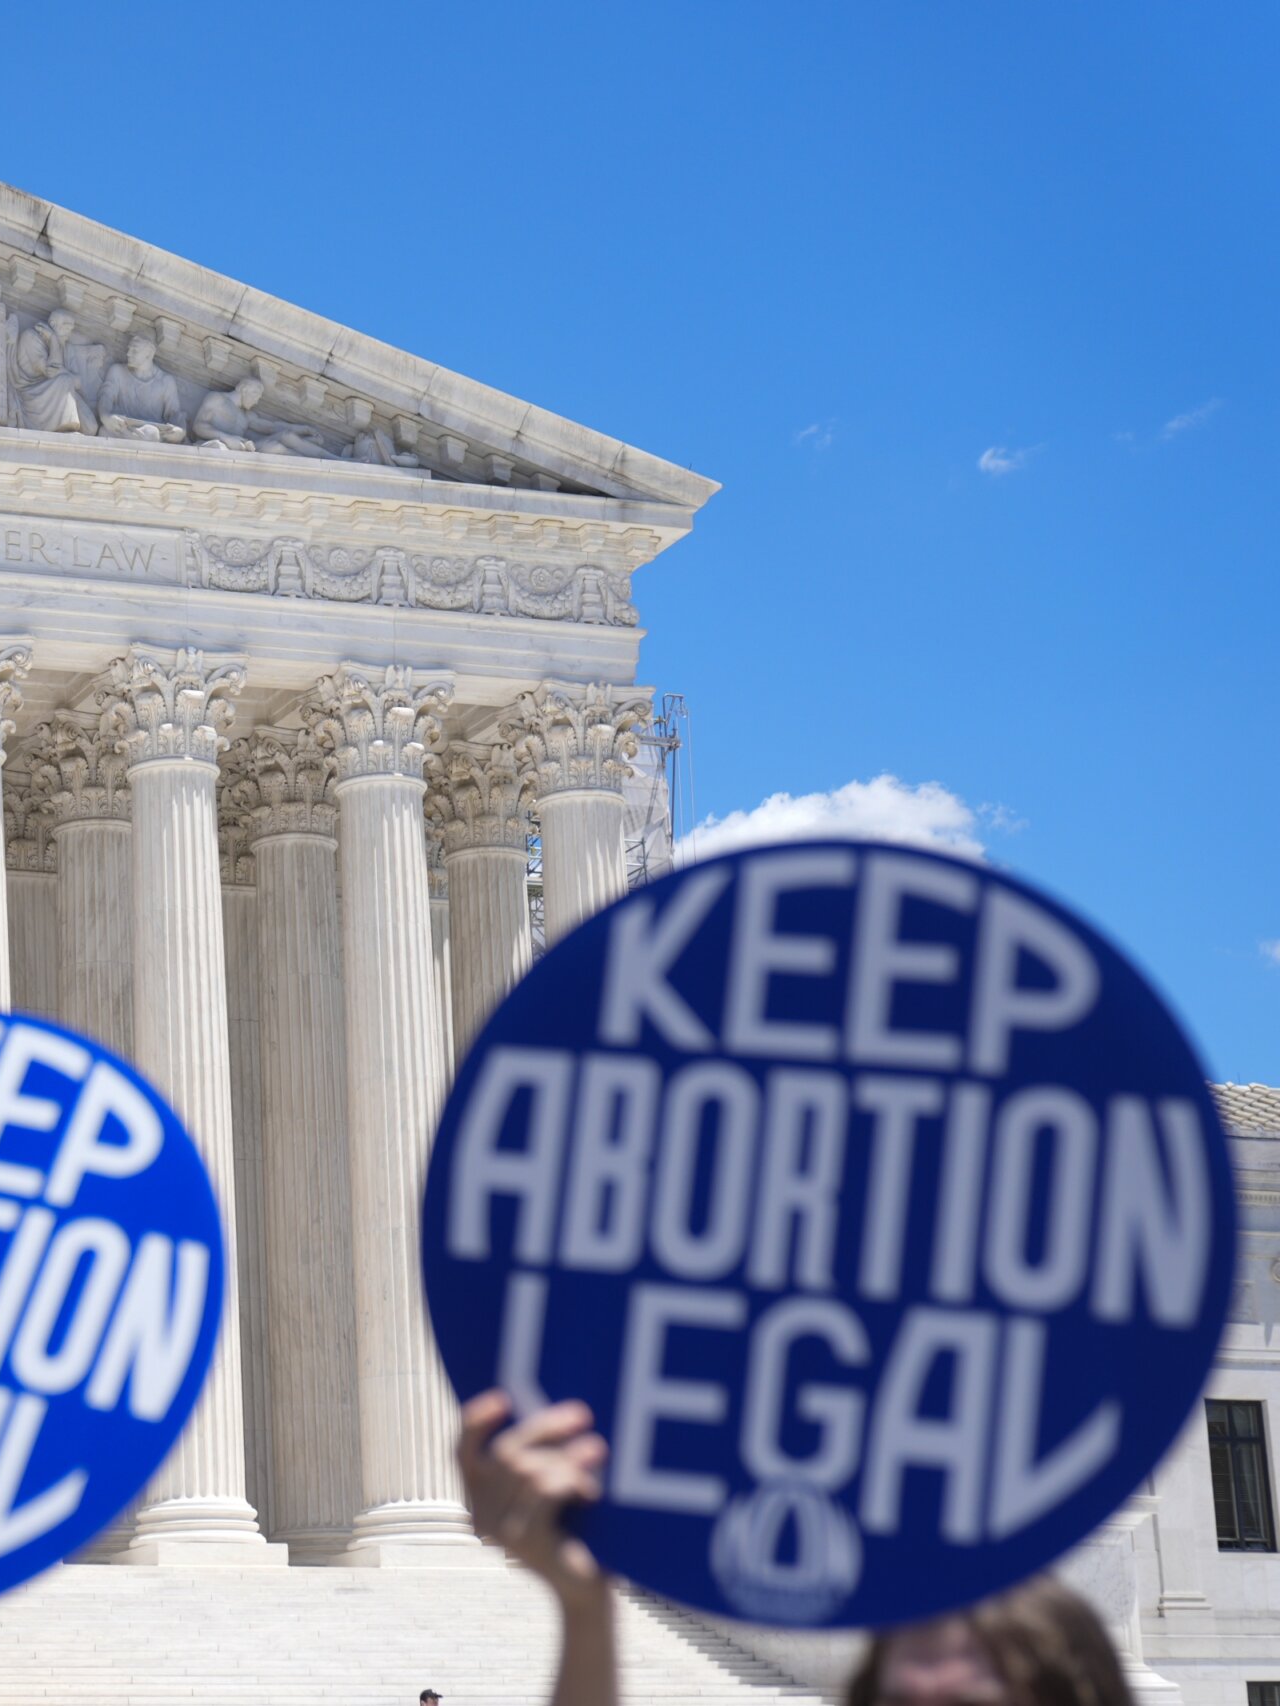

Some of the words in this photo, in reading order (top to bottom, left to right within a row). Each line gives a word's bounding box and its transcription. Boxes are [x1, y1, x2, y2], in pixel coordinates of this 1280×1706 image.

[71, 535, 156, 572] LAW
[599, 851, 1100, 1076] KEEP
[447, 1045, 1211, 1329] ABORTION
